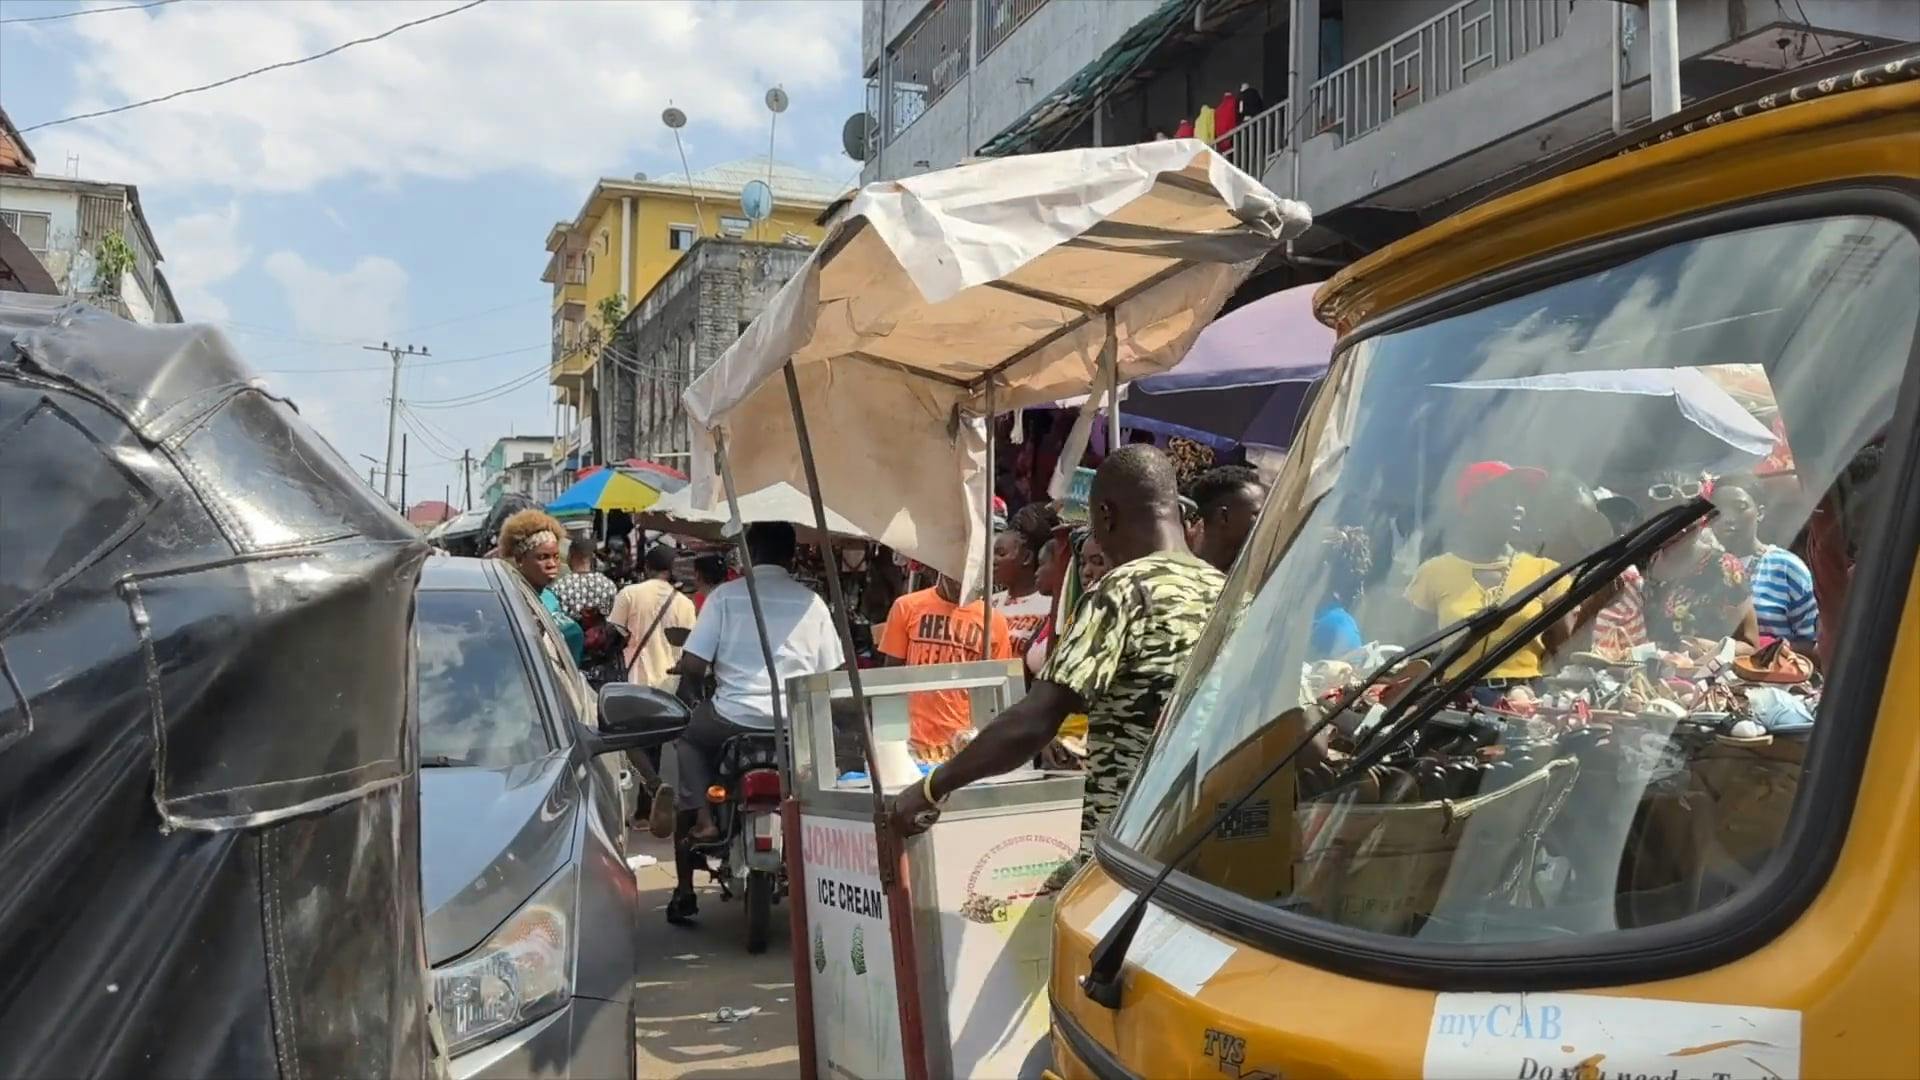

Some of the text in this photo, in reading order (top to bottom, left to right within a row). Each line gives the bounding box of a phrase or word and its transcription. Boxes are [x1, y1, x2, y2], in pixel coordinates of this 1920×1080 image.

[919, 613, 981, 647] HELLO
[804, 825, 878, 876] JOHNNE
[817, 877, 883, 920] ICE CREAM
[1437, 1003, 1563, 1048] myCAB
[1204, 1028, 1247, 1065] TVS
[1518, 1057, 1553, 1080] Do
